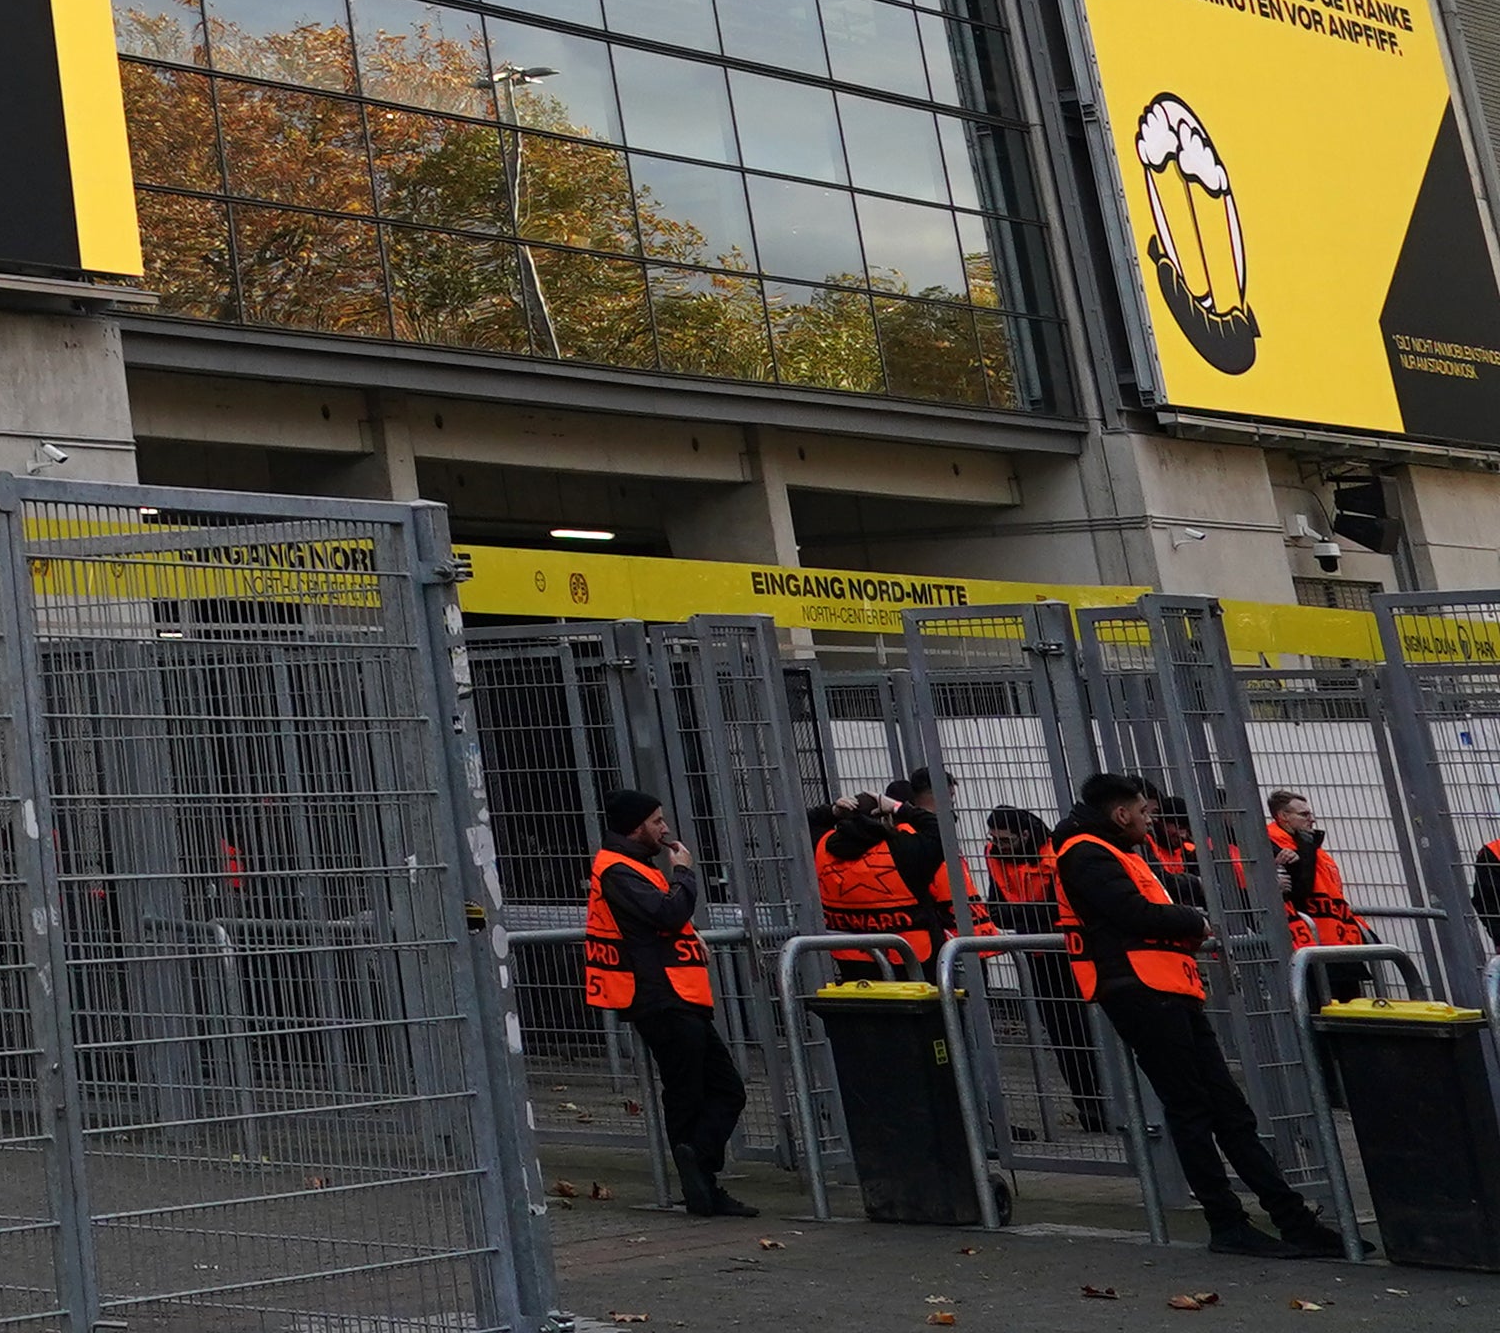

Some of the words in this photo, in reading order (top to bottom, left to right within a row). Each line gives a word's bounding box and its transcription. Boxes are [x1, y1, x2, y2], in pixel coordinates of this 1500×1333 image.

[1284, 2, 1327, 35] VOR
[1327, 14, 1404, 57] ANPFIFF.
[751, 571, 846, 600] EINGANG
[848, 577, 969, 607] NORD-MITTE
[802, 604, 879, 626] NORTH-CENTER
